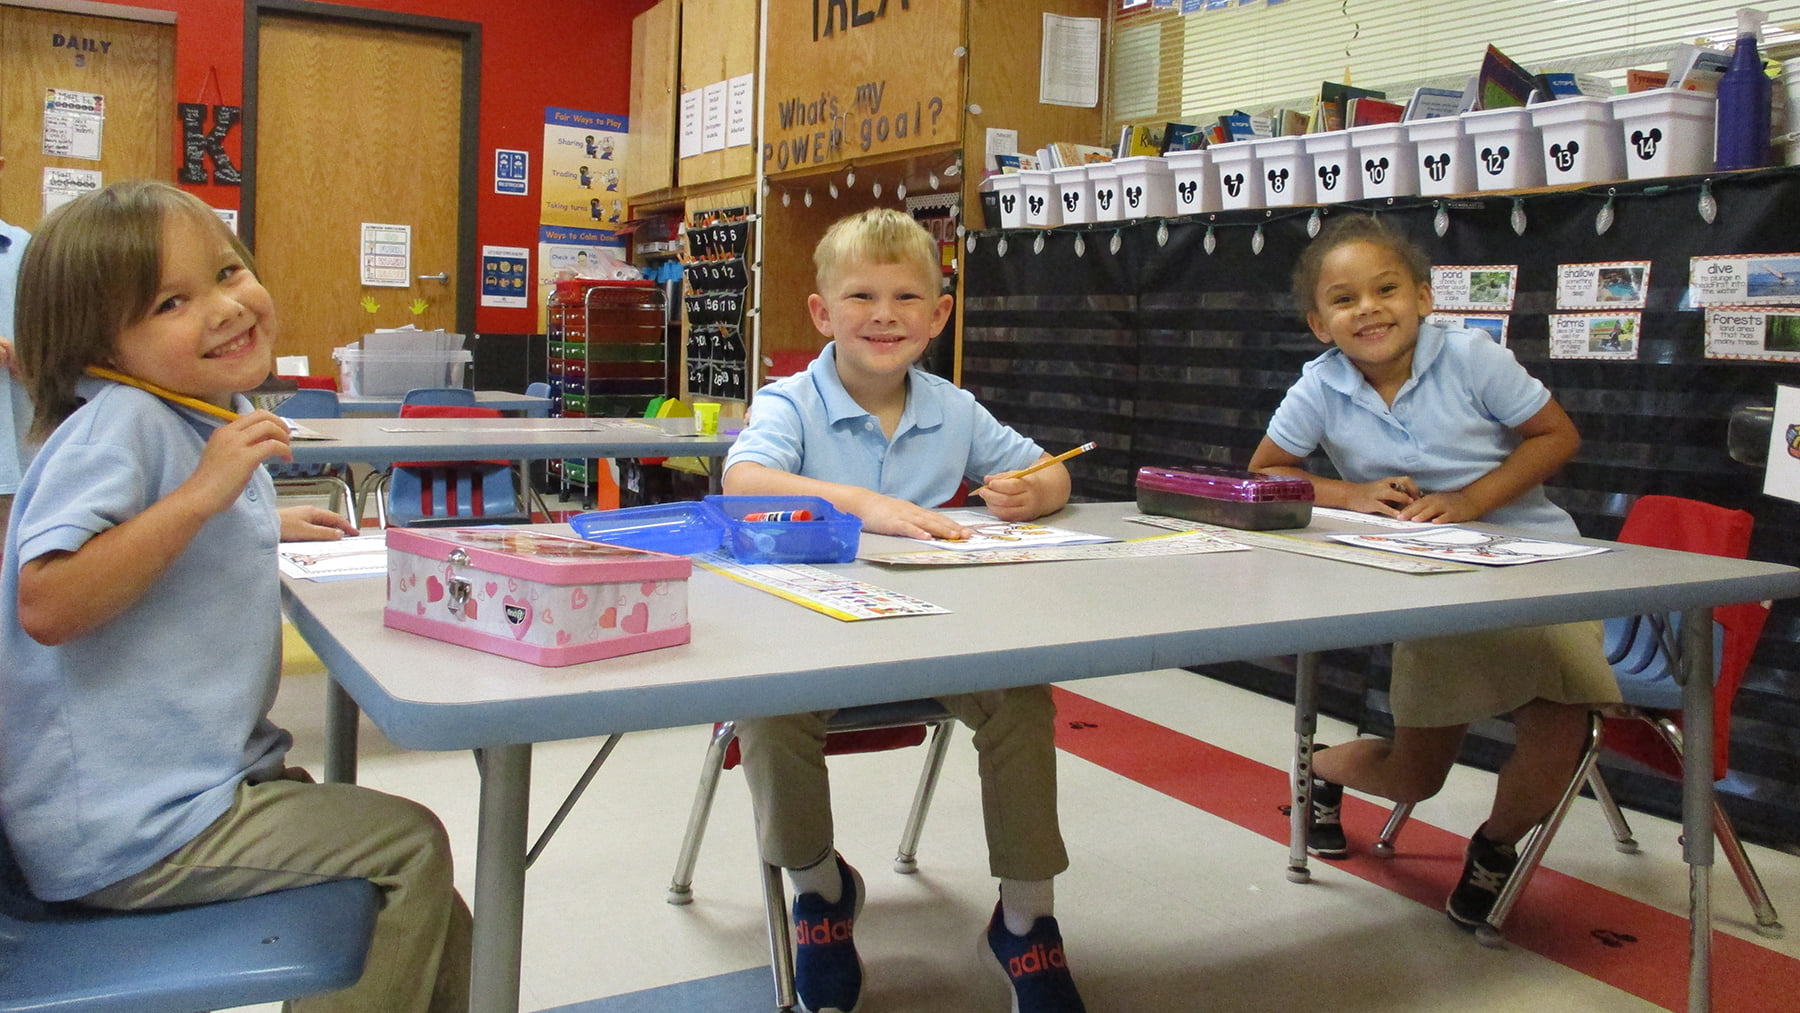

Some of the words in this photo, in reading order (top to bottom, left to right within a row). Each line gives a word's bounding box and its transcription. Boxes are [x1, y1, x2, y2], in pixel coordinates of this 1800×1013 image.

[53, 33, 111, 54] DAILY
[778, 90, 838, 130] What's
[854, 80, 885, 114] my
[555, 112, 570, 120] Fair
[574, 115, 594, 125] Ways
[607, 119, 622, 128] Play
[558, 138, 583, 148] Sharing
[1639, 138, 1654, 156] 14
[1487, 154, 1502, 172] 12
[1557, 151, 1571, 168] 13
[552, 170, 577, 180] Trading
[1370, 167, 1384, 183] 10
[1432, 162, 1443, 181] 11
[1231, 181, 1239, 196] 7
[1274, 176, 1282, 192] 8
[1325, 173, 1334, 189] 9
[1102, 194, 1109, 209] 4
[1131, 193, 1138, 206] 5
[1184, 188, 1192, 202] 6
[547, 202, 568, 211] Taking
[1032, 203, 1039, 215] 2
[1069, 199, 1075, 211] 3
[546, 231, 566, 240] Ways
[1442, 270, 1463, 280] pond
[1564, 268, 1595, 279] shallow
[1707, 263, 1733, 274] dive
